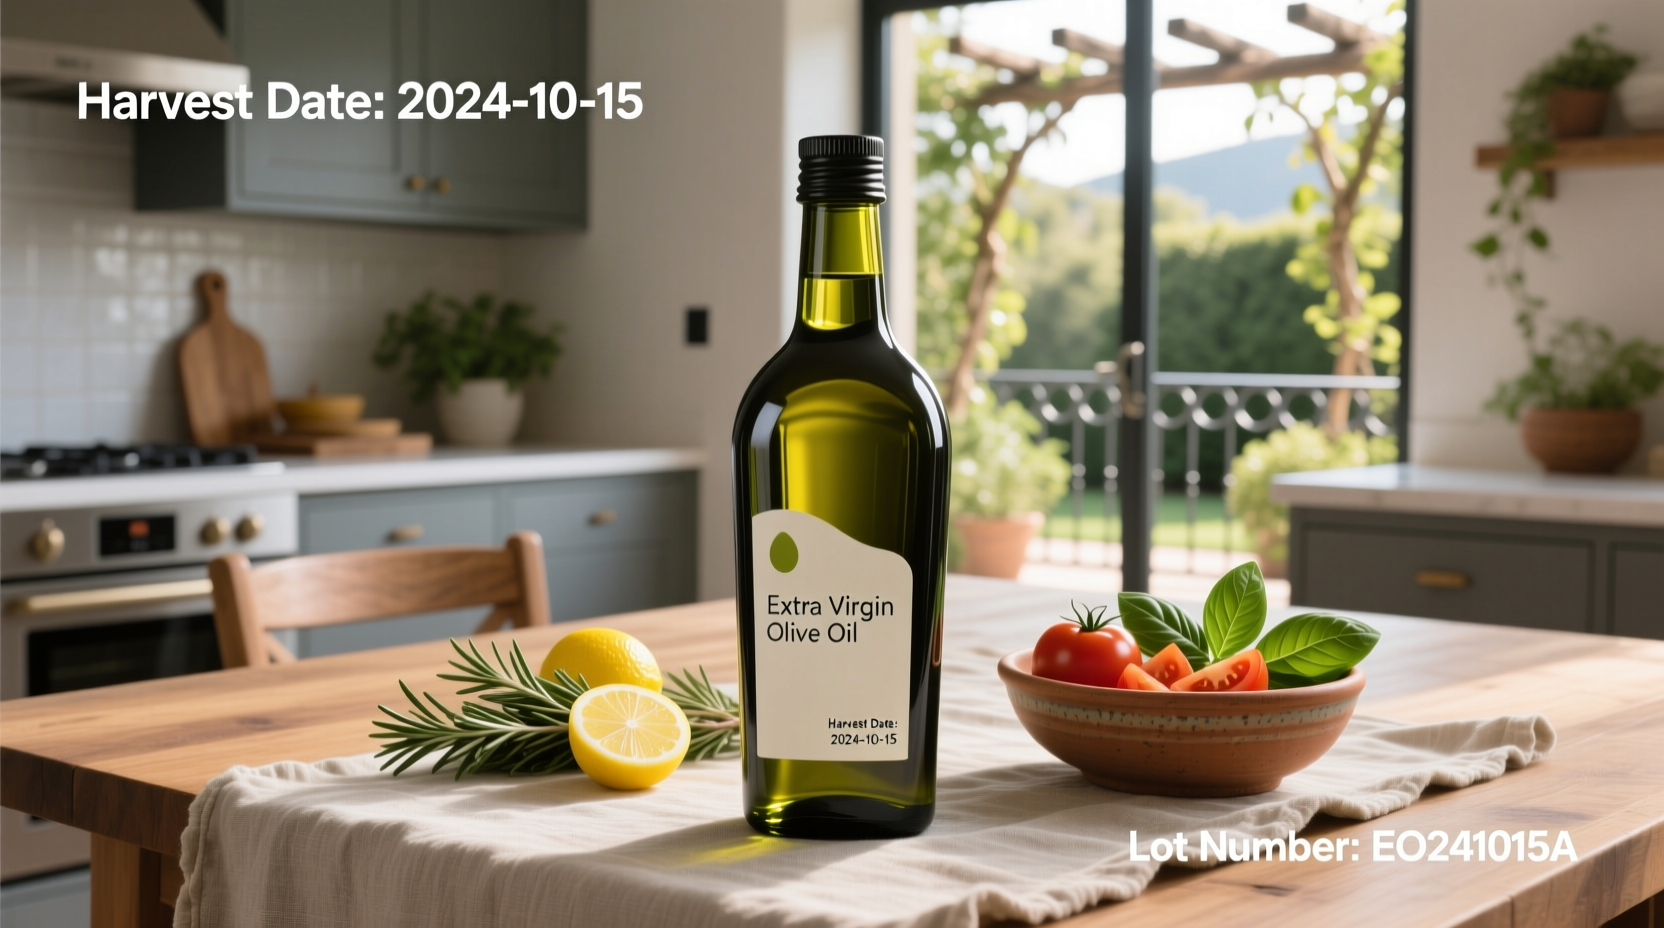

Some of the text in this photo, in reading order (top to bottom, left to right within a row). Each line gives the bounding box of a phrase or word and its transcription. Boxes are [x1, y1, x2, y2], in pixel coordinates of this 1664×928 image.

[767, 594, 894, 622] Extra Virgin
[767, 621, 857, 643] Olive Oil
[830, 733, 898, 745] 2024-10-15
